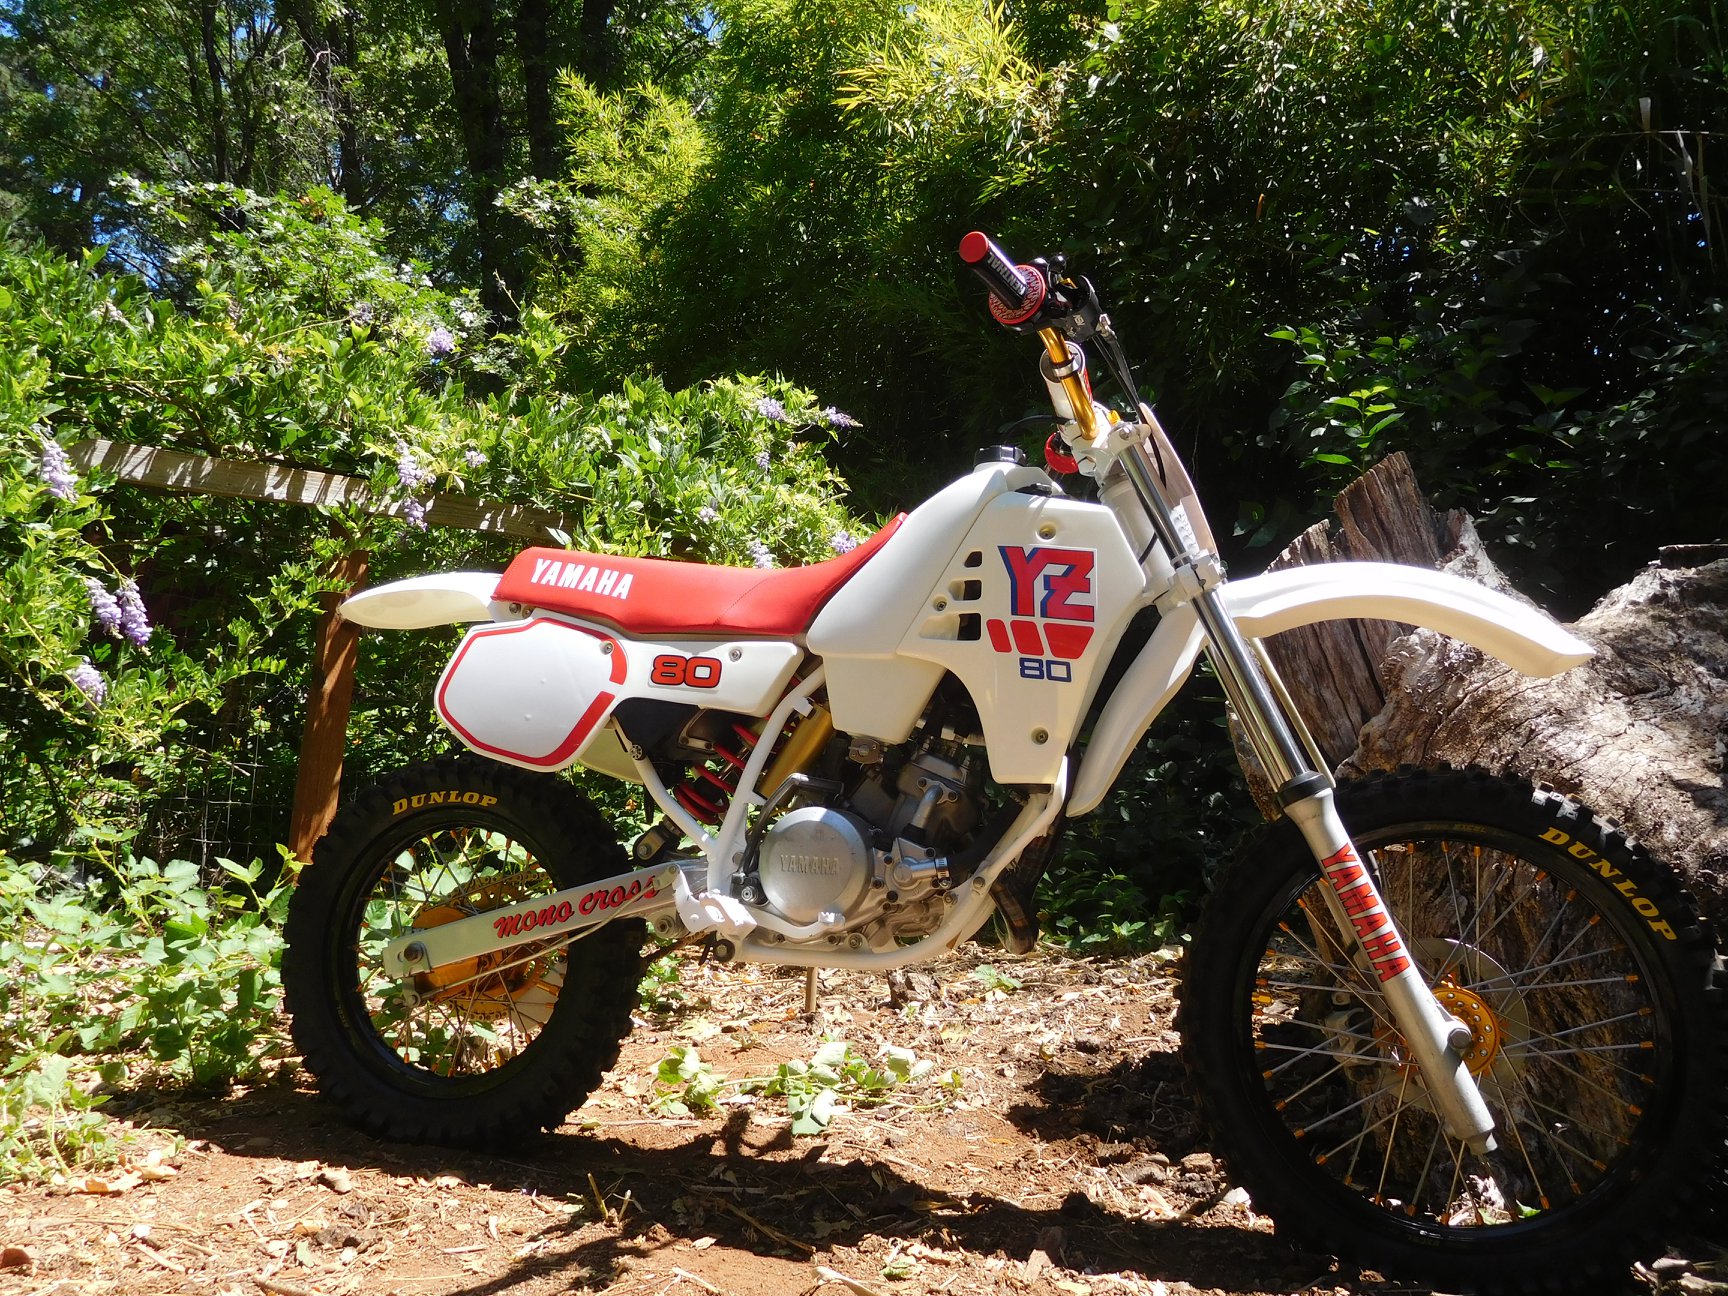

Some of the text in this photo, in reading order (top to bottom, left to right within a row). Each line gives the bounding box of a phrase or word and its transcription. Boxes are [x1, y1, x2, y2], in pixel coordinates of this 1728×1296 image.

[987, 251, 1026, 296] RENTHAL
[530, 558, 635, 600] YAMAHA
[997, 545, 1095, 622] YZ
[650, 654, 723, 689] 80
[1018, 657, 1073, 683] 80
[392, 790, 498, 816] DUNLOP
[780, 854, 840, 876] YAMAHA
[1538, 827, 1678, 941] DUNLOP
[493, 875, 660, 939] mono cross
[1321, 842, 1411, 984] YAMAHA
